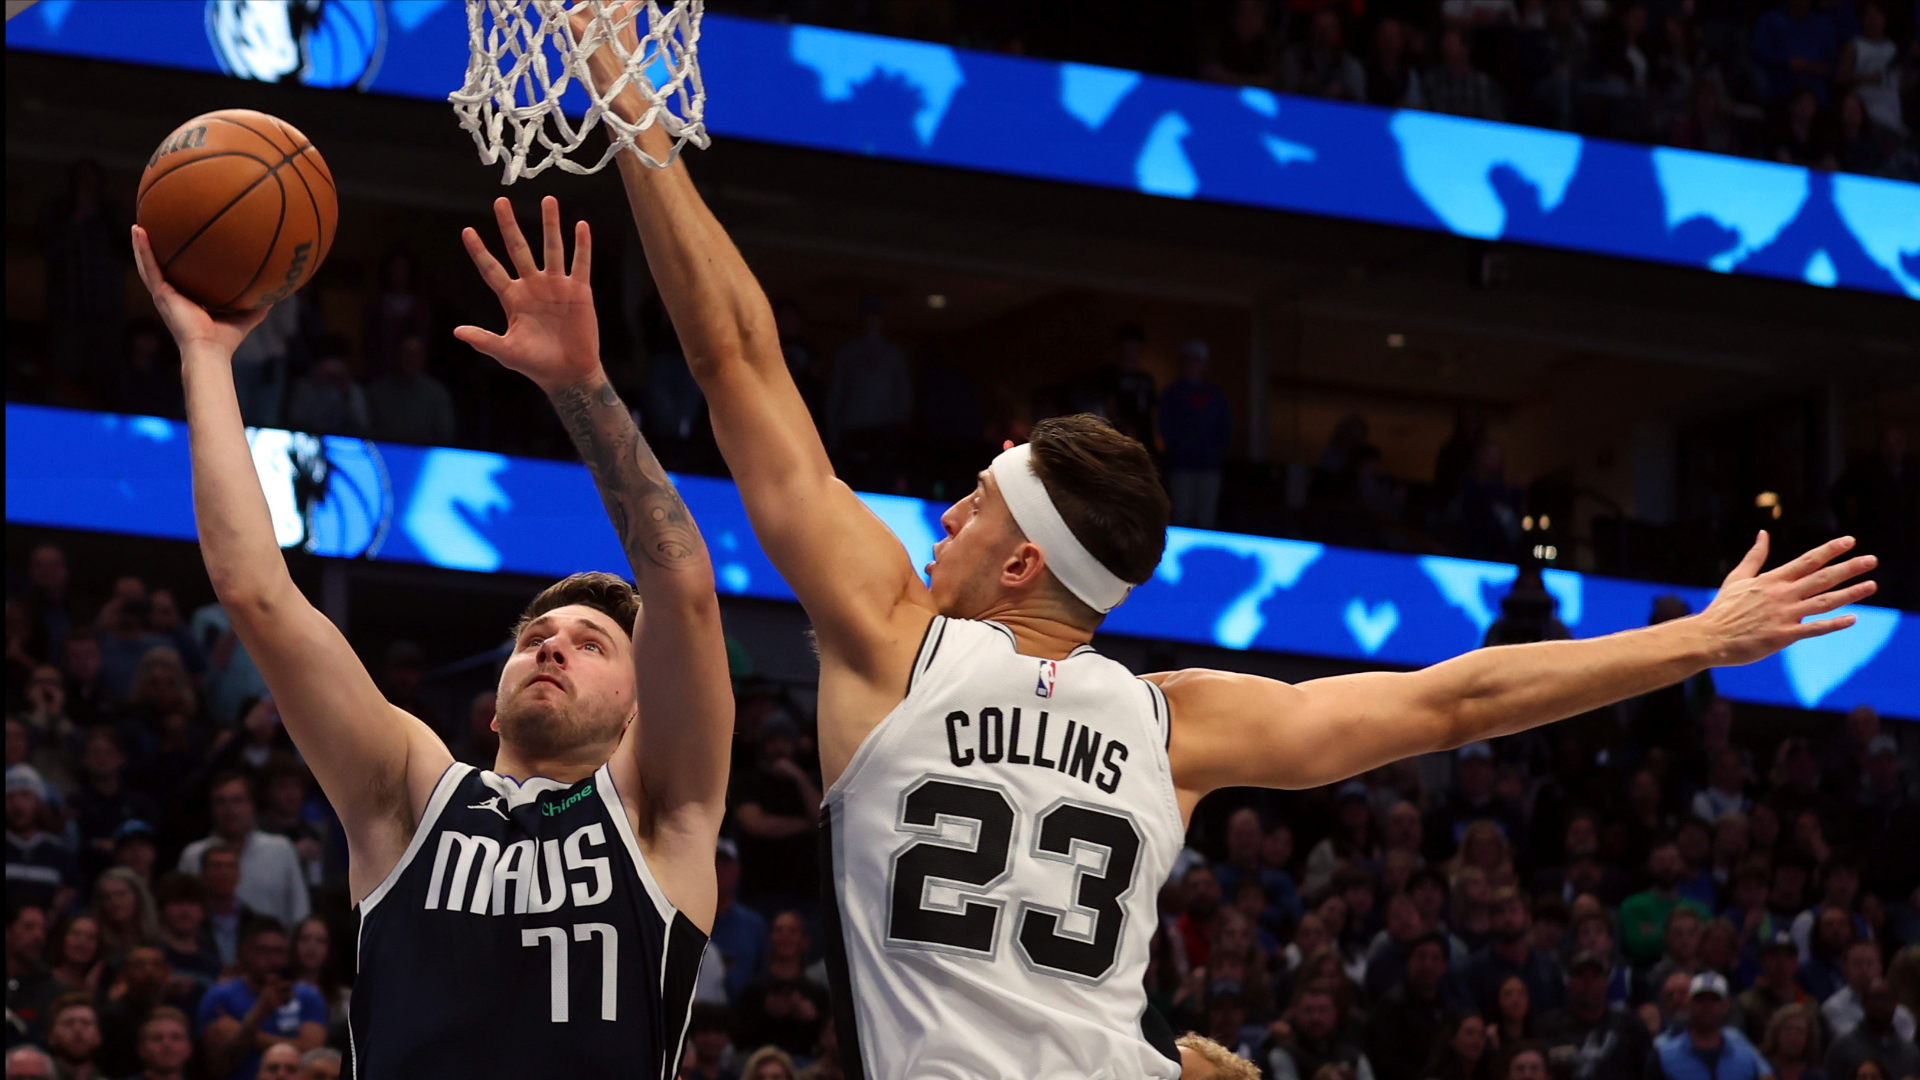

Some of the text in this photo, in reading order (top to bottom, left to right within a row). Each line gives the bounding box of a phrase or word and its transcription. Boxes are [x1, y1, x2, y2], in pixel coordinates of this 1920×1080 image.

[945, 706, 1129, 794] COLLINS
[541, 784, 593, 818] Chime
[424, 822, 613, 917] MAVS
[883, 772, 1147, 987] 23
[521, 922, 618, 1023] 77
